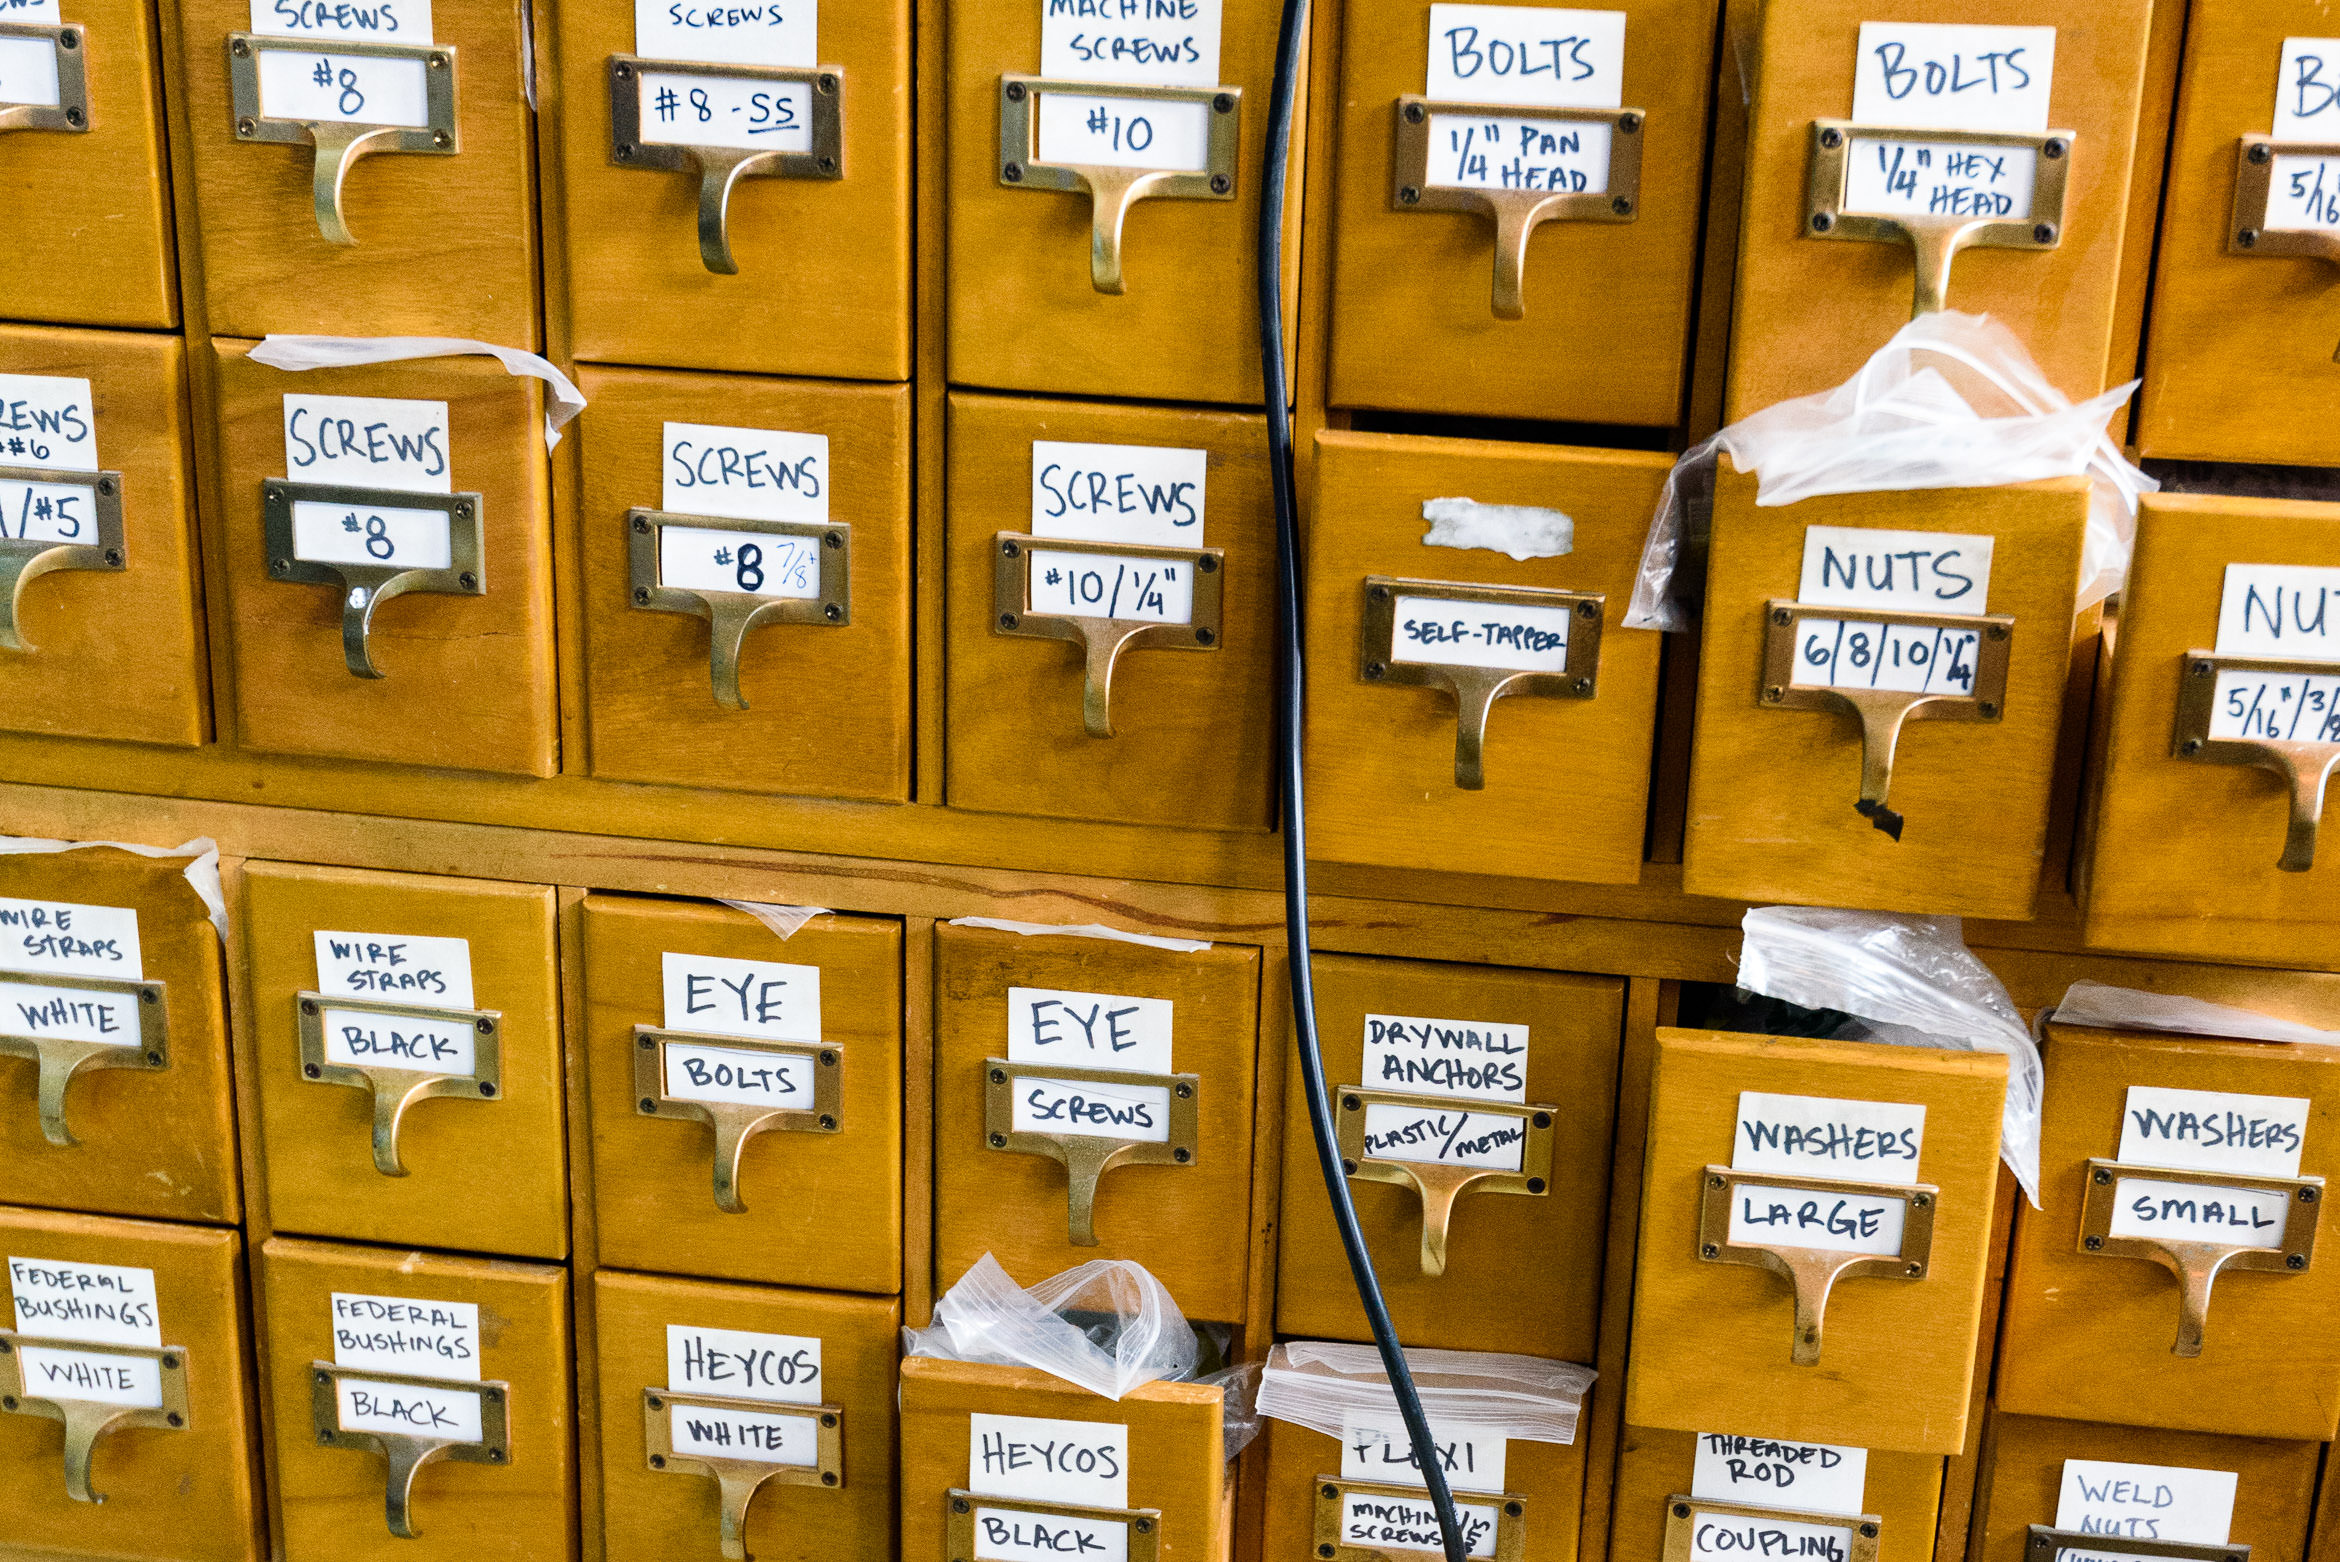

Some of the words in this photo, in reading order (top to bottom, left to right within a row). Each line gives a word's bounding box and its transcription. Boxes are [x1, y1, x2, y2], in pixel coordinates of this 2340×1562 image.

[274, 0, 399, 32] SCREWS
[669, 3, 784, 28] SCREWS
[1049, 0, 1199, 20] MACHINE
[1069, 33, 1201, 64] SCREWS
[1444, 26, 1596, 82] BOLTS
[312, 57, 365, 116] #8
[1873, 41, 2030, 100] BOLTS
[2292, 54, 2340, 118] B
[1086, 105, 1154, 152] #10
[1450, 123, 1500, 182] 1/4"
[1519, 125, 1581, 157] PAN
[1501, 156, 1588, 193] HEAD
[1878, 144, 1932, 200] 1/4"
[1946, 152, 2007, 184] HEX
[1929, 184, 2013, 217] HEAD
[2289, 162, 2340, 224] 5/16
[290, 408, 445, 476] SCREWS
[672, 440, 821, 498] SCREWS
[1040, 463, 1197, 527] SCREWS
[341, 512, 395, 560] #8
[713, 543, 765, 592] #8
[1822, 546, 1974, 600] NUTS
[2244, 584, 2340, 641] NU
[1403, 618, 1566, 652] SELF-TAPPER
[0, 907, 72, 932] WIRE
[23, 934, 123, 961] STRAPS
[329, 939, 407, 966] WIRE
[347, 969, 447, 994] STRAPS
[687, 973, 788, 1024] EYE
[16, 997, 120, 1034] WHITE
[1031, 1000, 1140, 1052] EYE
[342, 1026, 458, 1061] BLACK
[1369, 1019, 1526, 1055] DRYWALL
[682, 1057, 797, 1093] BOLTS
[1382, 1054, 1524, 1092] ANCHORS
[1028, 1088, 1153, 1128] SCREWS
[1742, 1120, 1918, 1160] WASHERS
[2131, 1108, 2300, 1153] WASHERS
[1743, 1198, 1886, 1241] LARGE
[2132, 1195, 2275, 1229] SMALL
[11, 1263, 135, 1293] FEDERAL
[14, 1296, 154, 1329] BUSHINGS
[336, 1299, 468, 1329] FEDERAL
[336, 1329, 472, 1360] BUSHINGS
[684, 1336, 820, 1388] HEYCOS
[39, 1361, 135, 1390] WHITE
[350, 1391, 460, 1429] BLACK
[686, 1419, 784, 1451] WHITE
[1702, 1432, 1843, 1470] THREADED
[982, 1431, 1120, 1479] HEYCOS
[1725, 1458, 1796, 1488] ROD
[2077, 1474, 2174, 1509] WELD
[1352, 1503, 1440, 1526] MACHIN
[2080, 1514, 2160, 1539] NUTS
[981, 1517, 1107, 1554] BLACK
[1350, 1523, 1444, 1546] SCREWS
[1696, 1523, 1845, 1562] COUPLING
